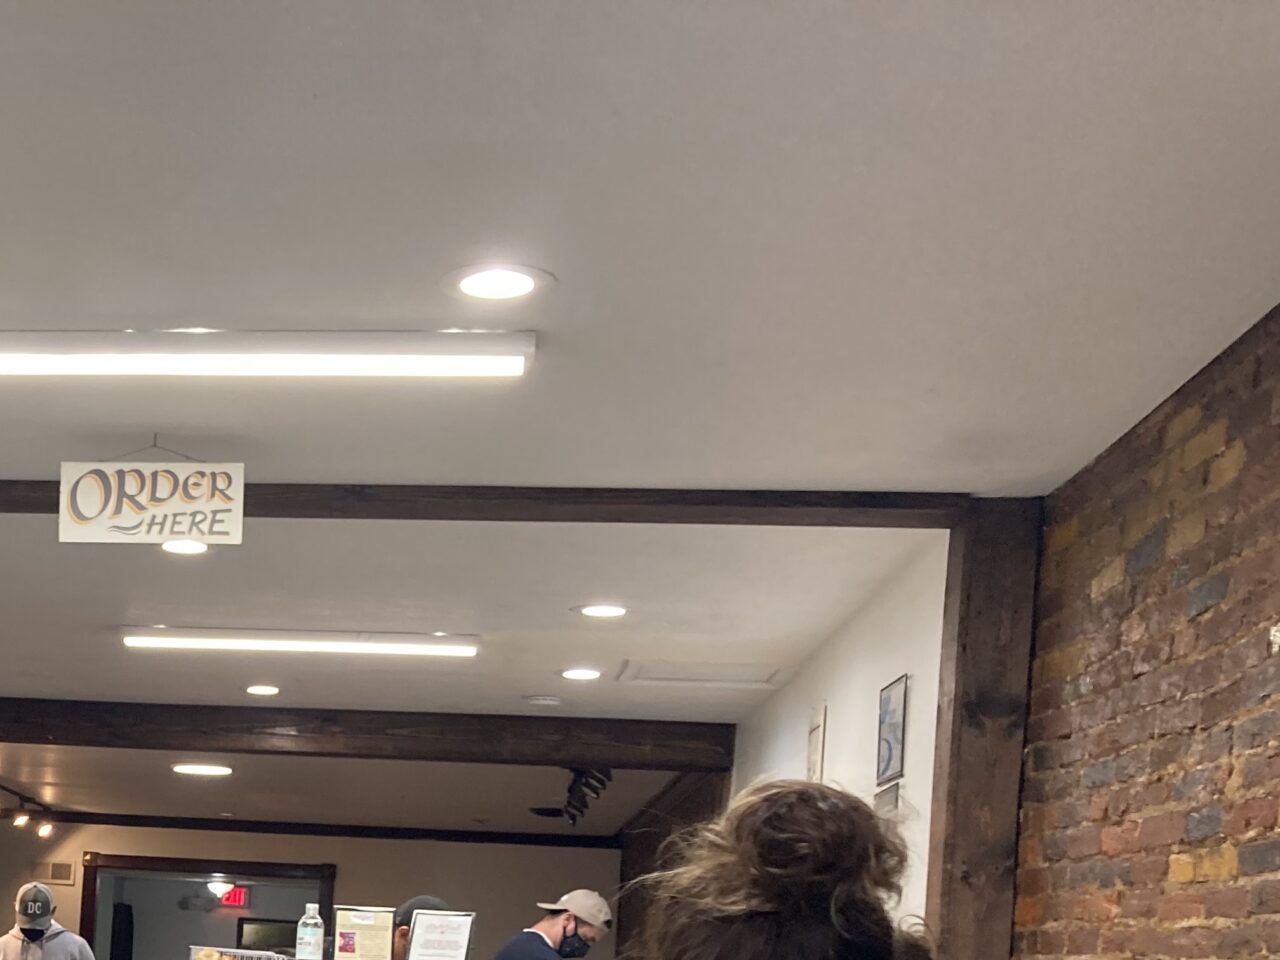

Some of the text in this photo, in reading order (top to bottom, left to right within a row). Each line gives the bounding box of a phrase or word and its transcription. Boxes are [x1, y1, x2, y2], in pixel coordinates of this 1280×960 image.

[67, 468, 234, 526] ORDER
[146, 508, 232, 536] HERE
[27, 902, 42, 914] DC
